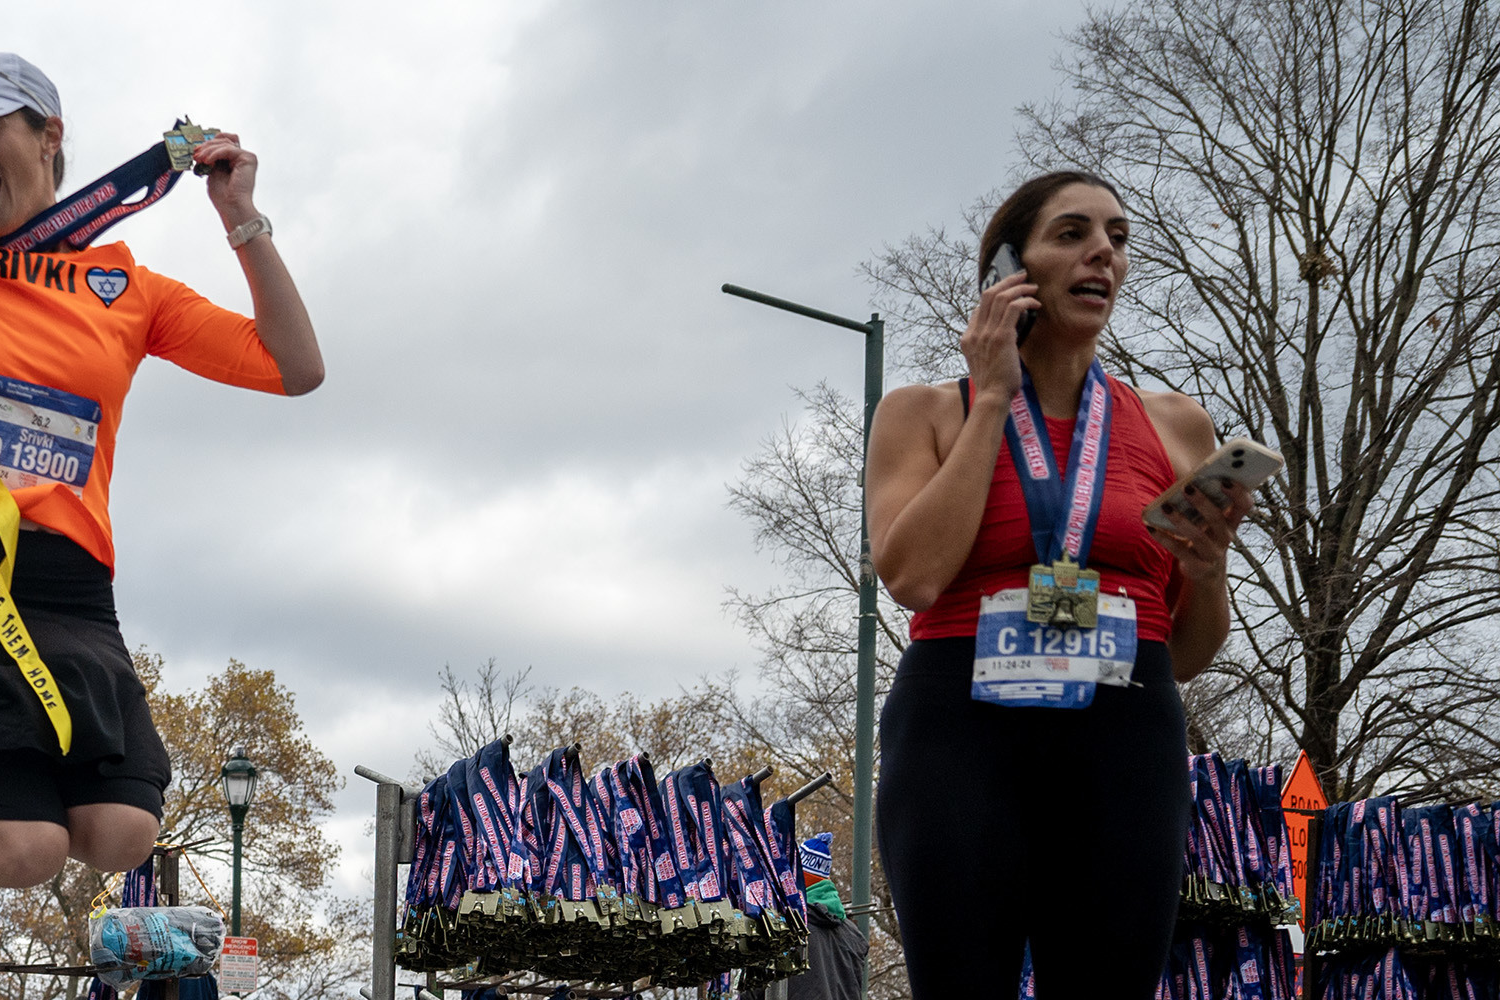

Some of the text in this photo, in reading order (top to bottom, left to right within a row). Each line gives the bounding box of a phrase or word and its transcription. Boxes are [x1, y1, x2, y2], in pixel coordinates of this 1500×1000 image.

[91, 181, 117, 203] 2024
[29, 194, 97, 242] PHILADELPHIA
[1088, 381, 1107, 421] WEEKEND
[19, 429, 54, 448] Srivki
[31, 414, 51, 428] 26.2
[1021, 434, 1051, 480] WEEKEND
[1081, 422, 1102, 465] MARATHON
[11, 443, 79, 483] 13900
[1069, 467, 1094, 530] PHILADELPHIA
[997, 627, 1117, 658] C 12915
[1, 613, 31, 659] THEM
[27, 667, 58, 710] HOME
[991, 660, 1032, 670] 11-24-24
[471, 791, 489, 818] WEEKEND
[1290, 795, 1319, 811] ROAD
[700, 800, 716, 854] MARATHON WEEKEND
[571, 863, 580, 876] 2024
